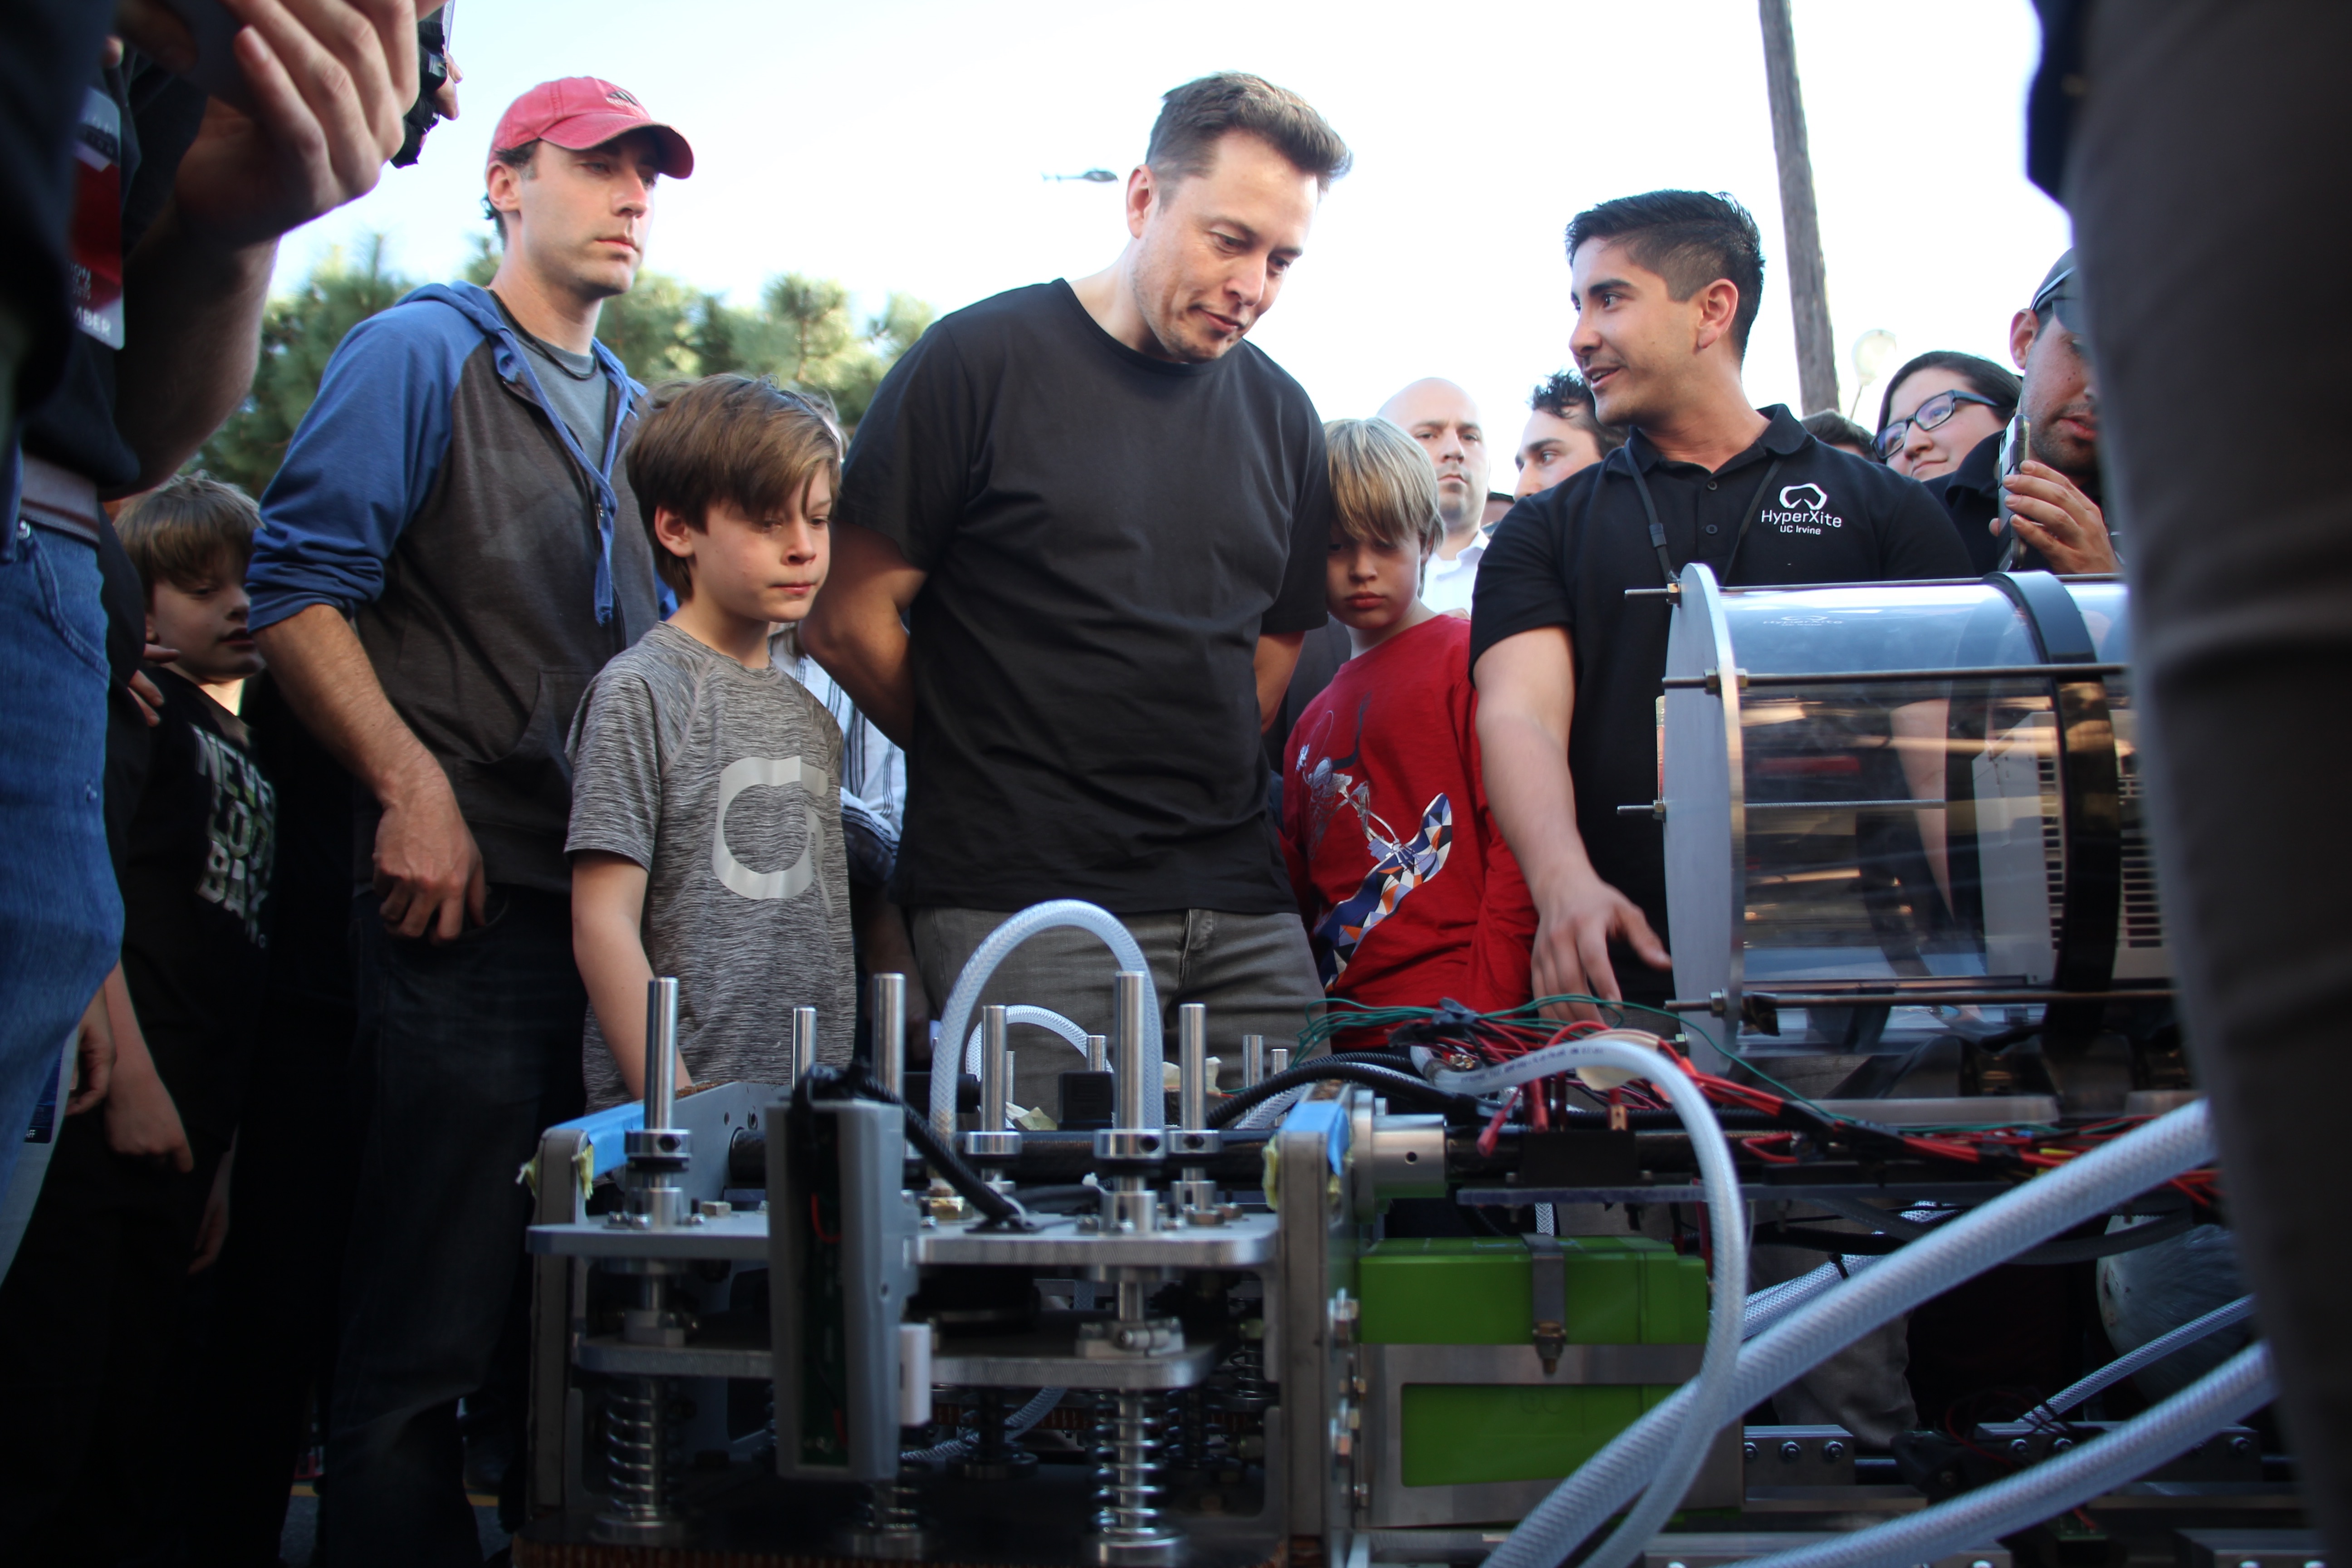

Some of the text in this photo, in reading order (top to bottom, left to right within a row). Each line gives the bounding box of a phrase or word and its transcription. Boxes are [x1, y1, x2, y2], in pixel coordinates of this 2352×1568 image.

[1761, 510, 1842, 528] HyperXite
[1780, 525, 1821, 535] UC Irvine
